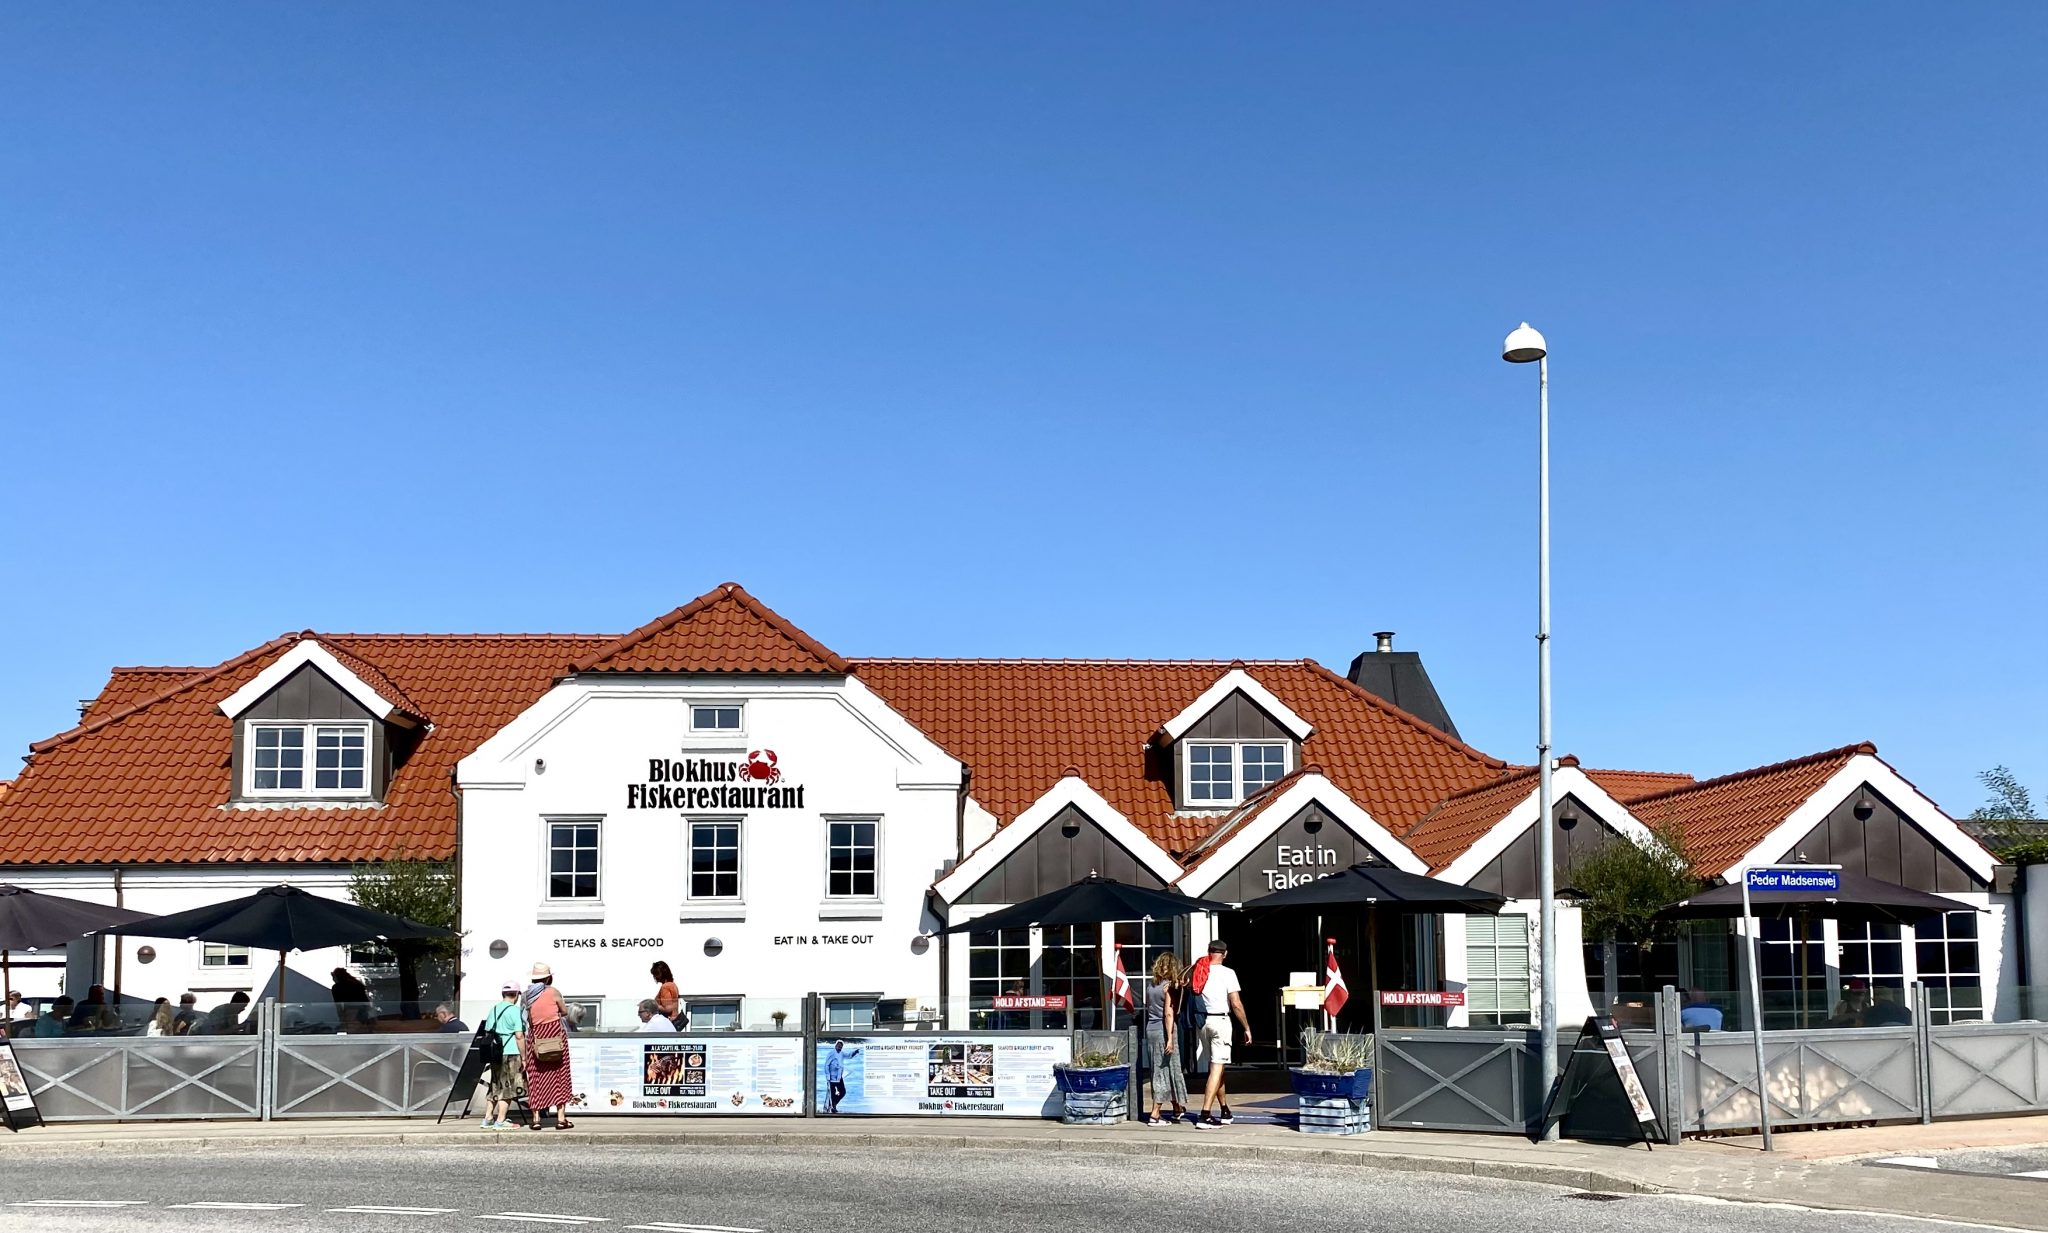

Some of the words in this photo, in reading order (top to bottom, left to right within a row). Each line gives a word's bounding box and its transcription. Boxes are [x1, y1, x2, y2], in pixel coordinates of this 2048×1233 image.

[649, 759, 737, 782] Blokhus
[627, 784, 805, 809] Fiskerestaurant
[1277, 845, 1314, 866] Eat
[1317, 844, 1337, 865] in
[1262, 868, 1313, 890] Take
[1750, 874, 1779, 886] Peder
[1781, 874, 1836, 889] Madsensvej
[553, 939, 596, 948] STEAKS
[600, 939, 607, 948] &
[611, 938, 664, 947] SEAFOOD
[774, 936, 794, 945] EAT
[796, 936, 807, 945] IN
[811, 936, 819, 944] &
[821, 935, 849, 945] TAKE
[851, 935, 874, 944] OUT
[995, 997, 1014, 1007] HOLD
[1014, 997, 1046, 1007] AFSTAND
[1383, 993, 1404, 1004] HOLD
[1405, 993, 1442, 1004] AFSTAND
[645, 1087, 660, 1095] TAKE
[660, 1087, 671, 1095] OUT
[929, 1087, 944, 1096] TAKE
[944, 1087, 956, 1096] OUT
[632, 1100, 657, 1109] Blokhus
[668, 1100, 718, 1109] Fiskerestaurant
[918, 1102, 943, 1110] Blokhus
[954, 1102, 1004, 1111] Fiskerestaurant
